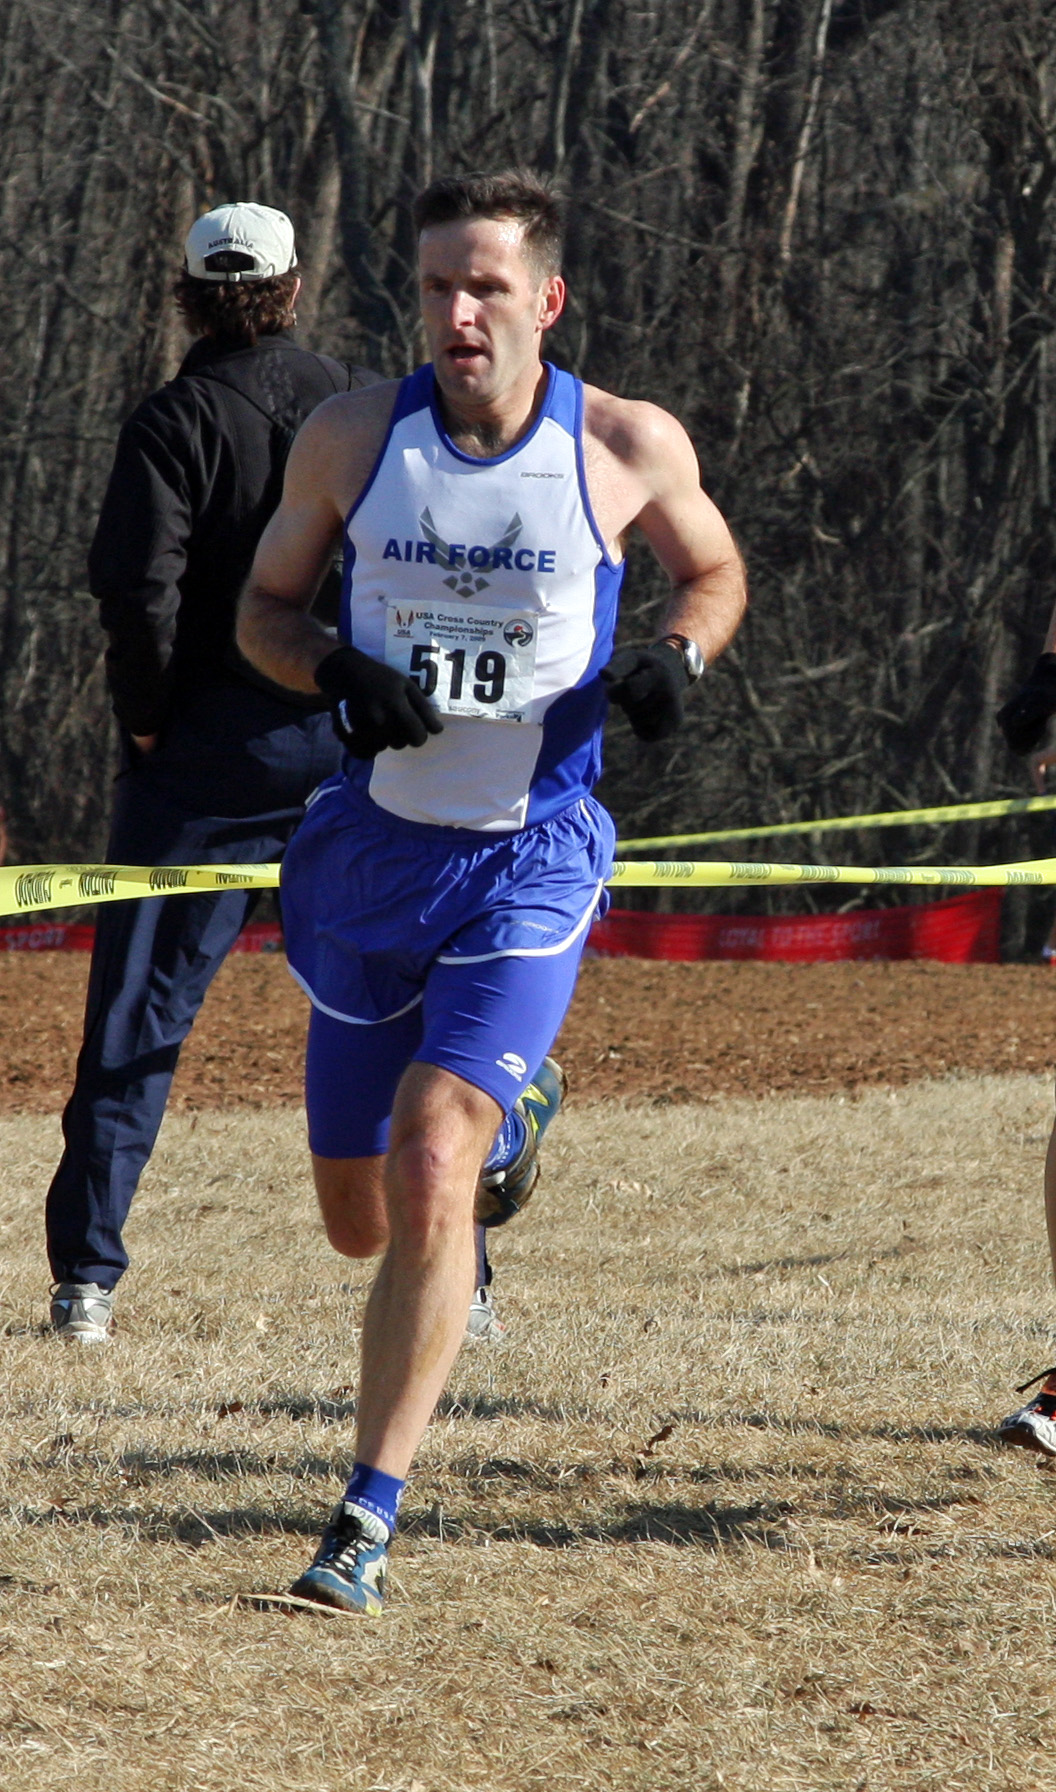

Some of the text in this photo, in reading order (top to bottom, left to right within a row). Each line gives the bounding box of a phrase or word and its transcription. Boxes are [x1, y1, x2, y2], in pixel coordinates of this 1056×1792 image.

[208, 238, 254, 249] AUSTRALIA
[382, 539, 556, 573] AIR FORCE
[415, 612, 503, 629] USA Cross Country
[424, 621, 494, 636] Championships
[409, 643, 506, 704] 519
